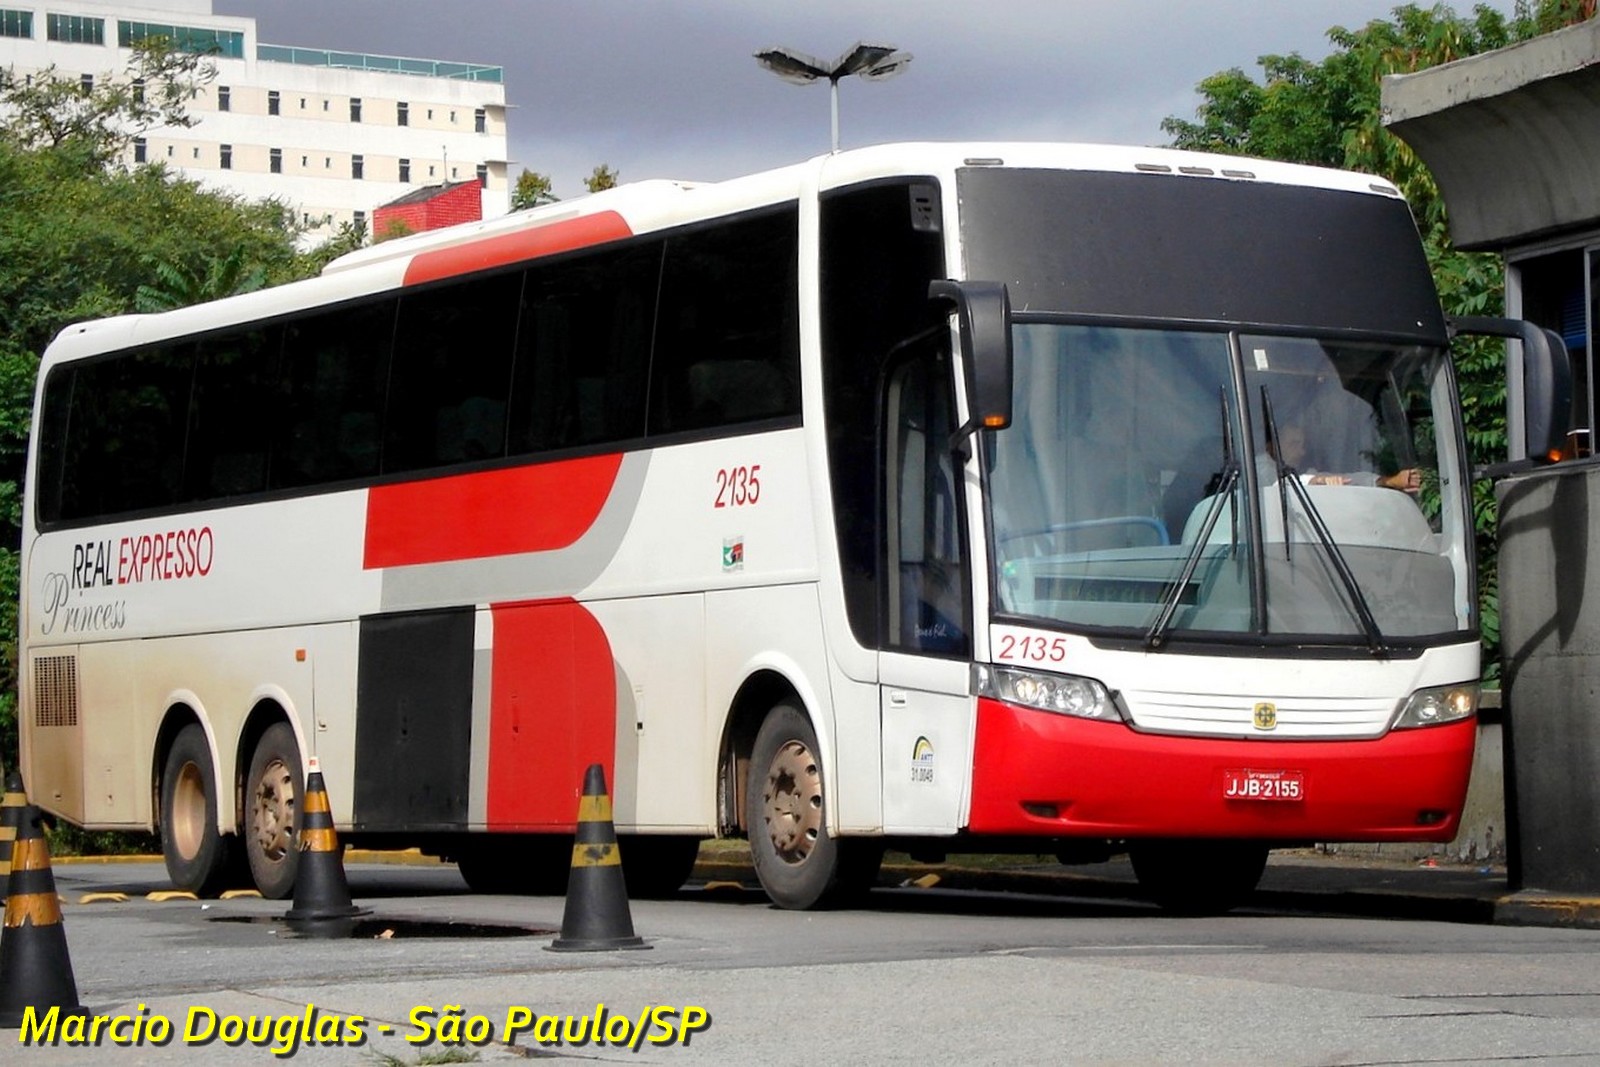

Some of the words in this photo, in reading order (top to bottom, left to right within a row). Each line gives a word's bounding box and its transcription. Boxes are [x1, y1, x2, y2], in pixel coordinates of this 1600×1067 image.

[714, 465, 760, 508] 2135
[71, 540, 113, 589] REAL
[117, 527, 213, 584] EXPRESSO
[41, 572, 126, 635] Princess
[999, 635, 1066, 661] 2135
